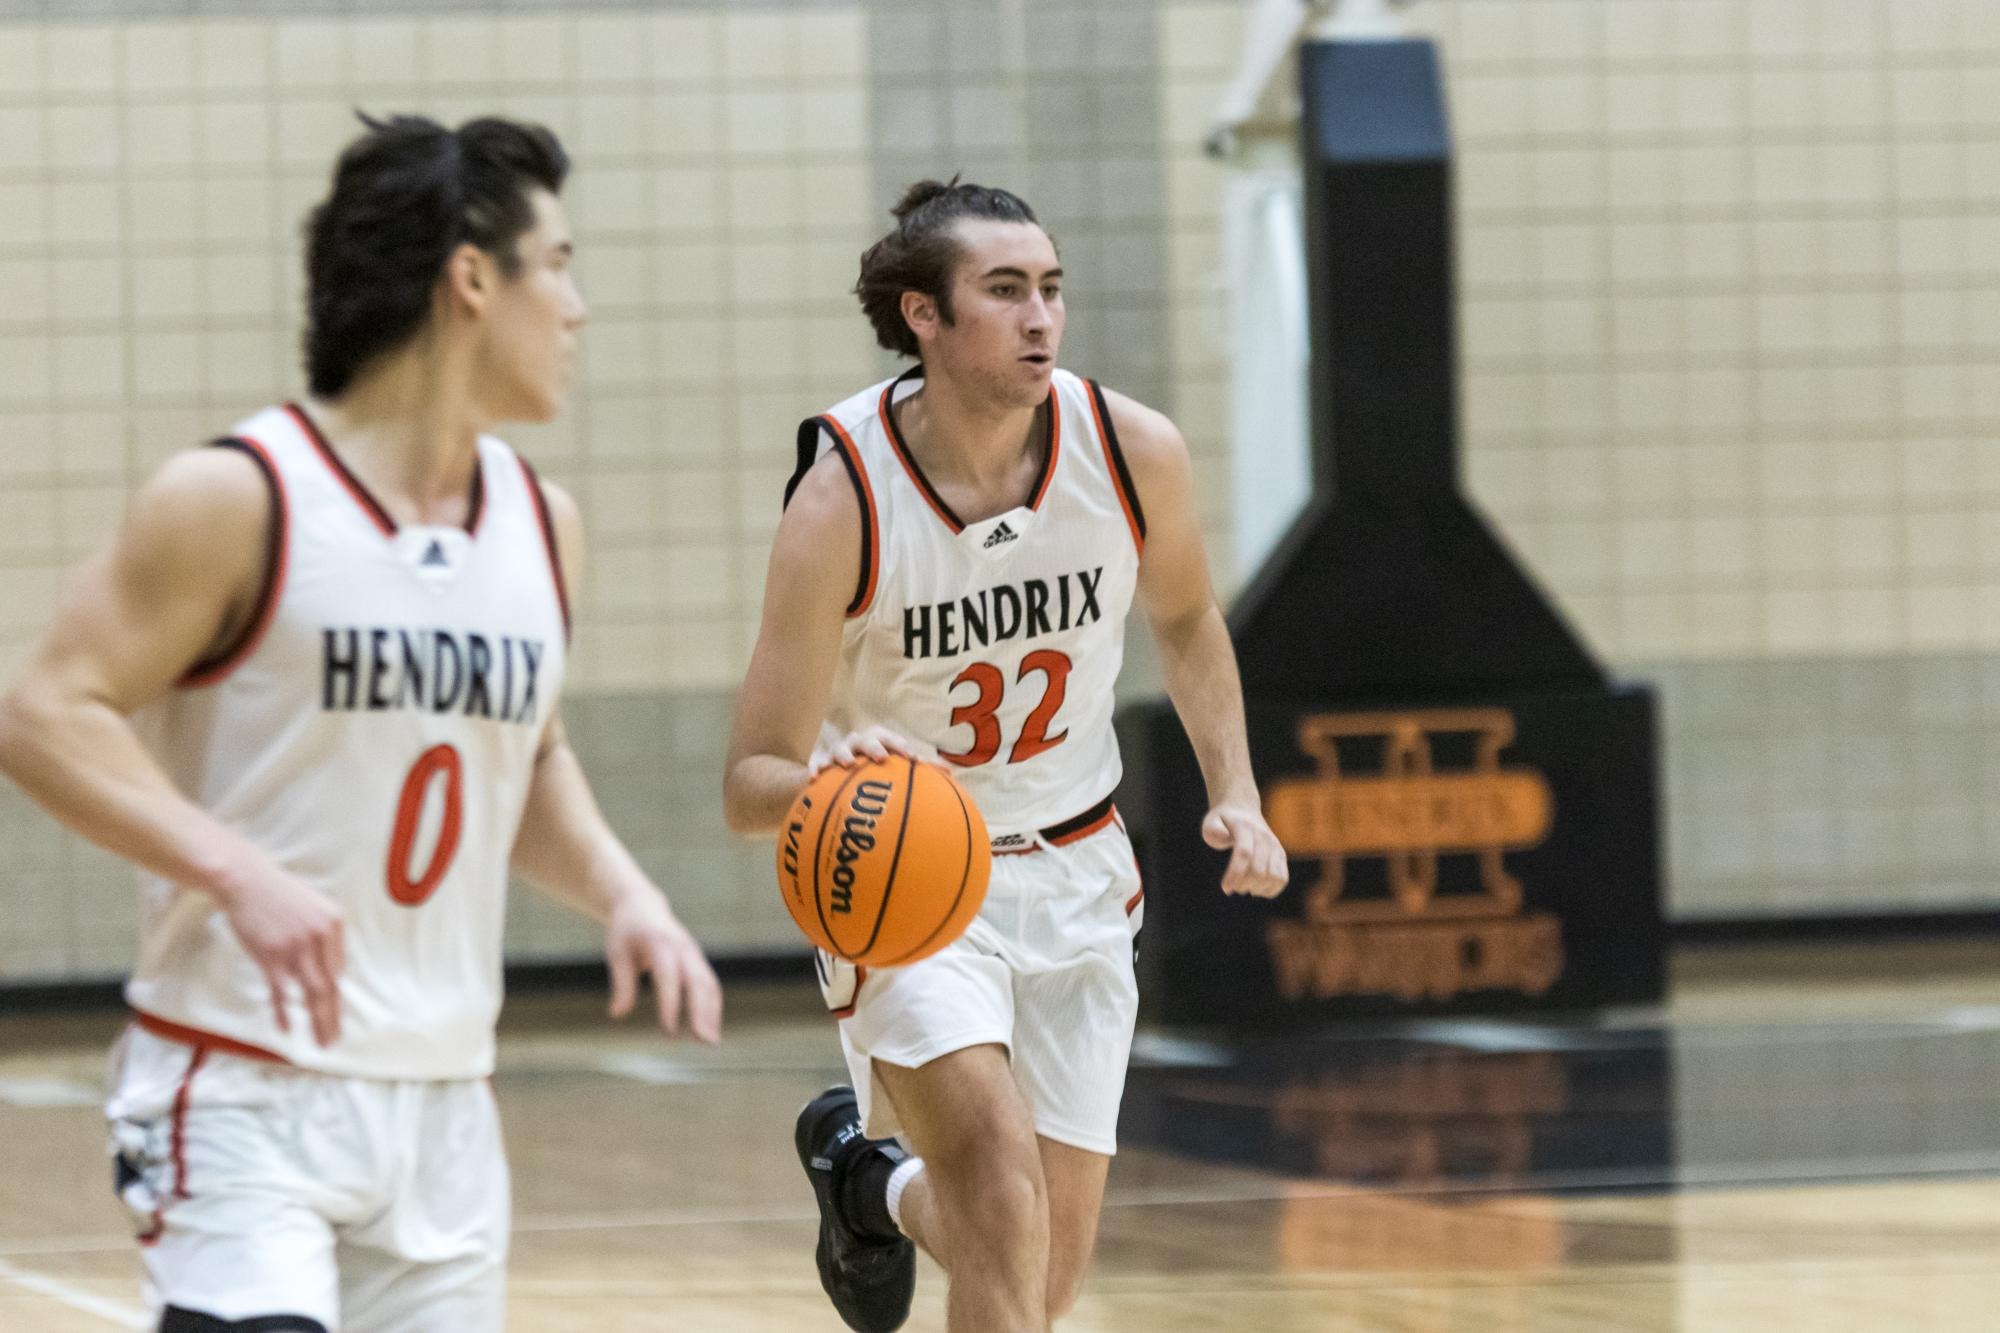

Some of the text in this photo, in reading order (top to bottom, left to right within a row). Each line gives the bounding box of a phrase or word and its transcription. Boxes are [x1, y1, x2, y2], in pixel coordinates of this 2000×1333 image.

[903, 566, 1103, 659] HENDRIX
[321, 627, 543, 726] HENDRIX
[937, 648, 1073, 768] 32
[385, 743, 464, 908] 0
[830, 780, 892, 914] Wilson
